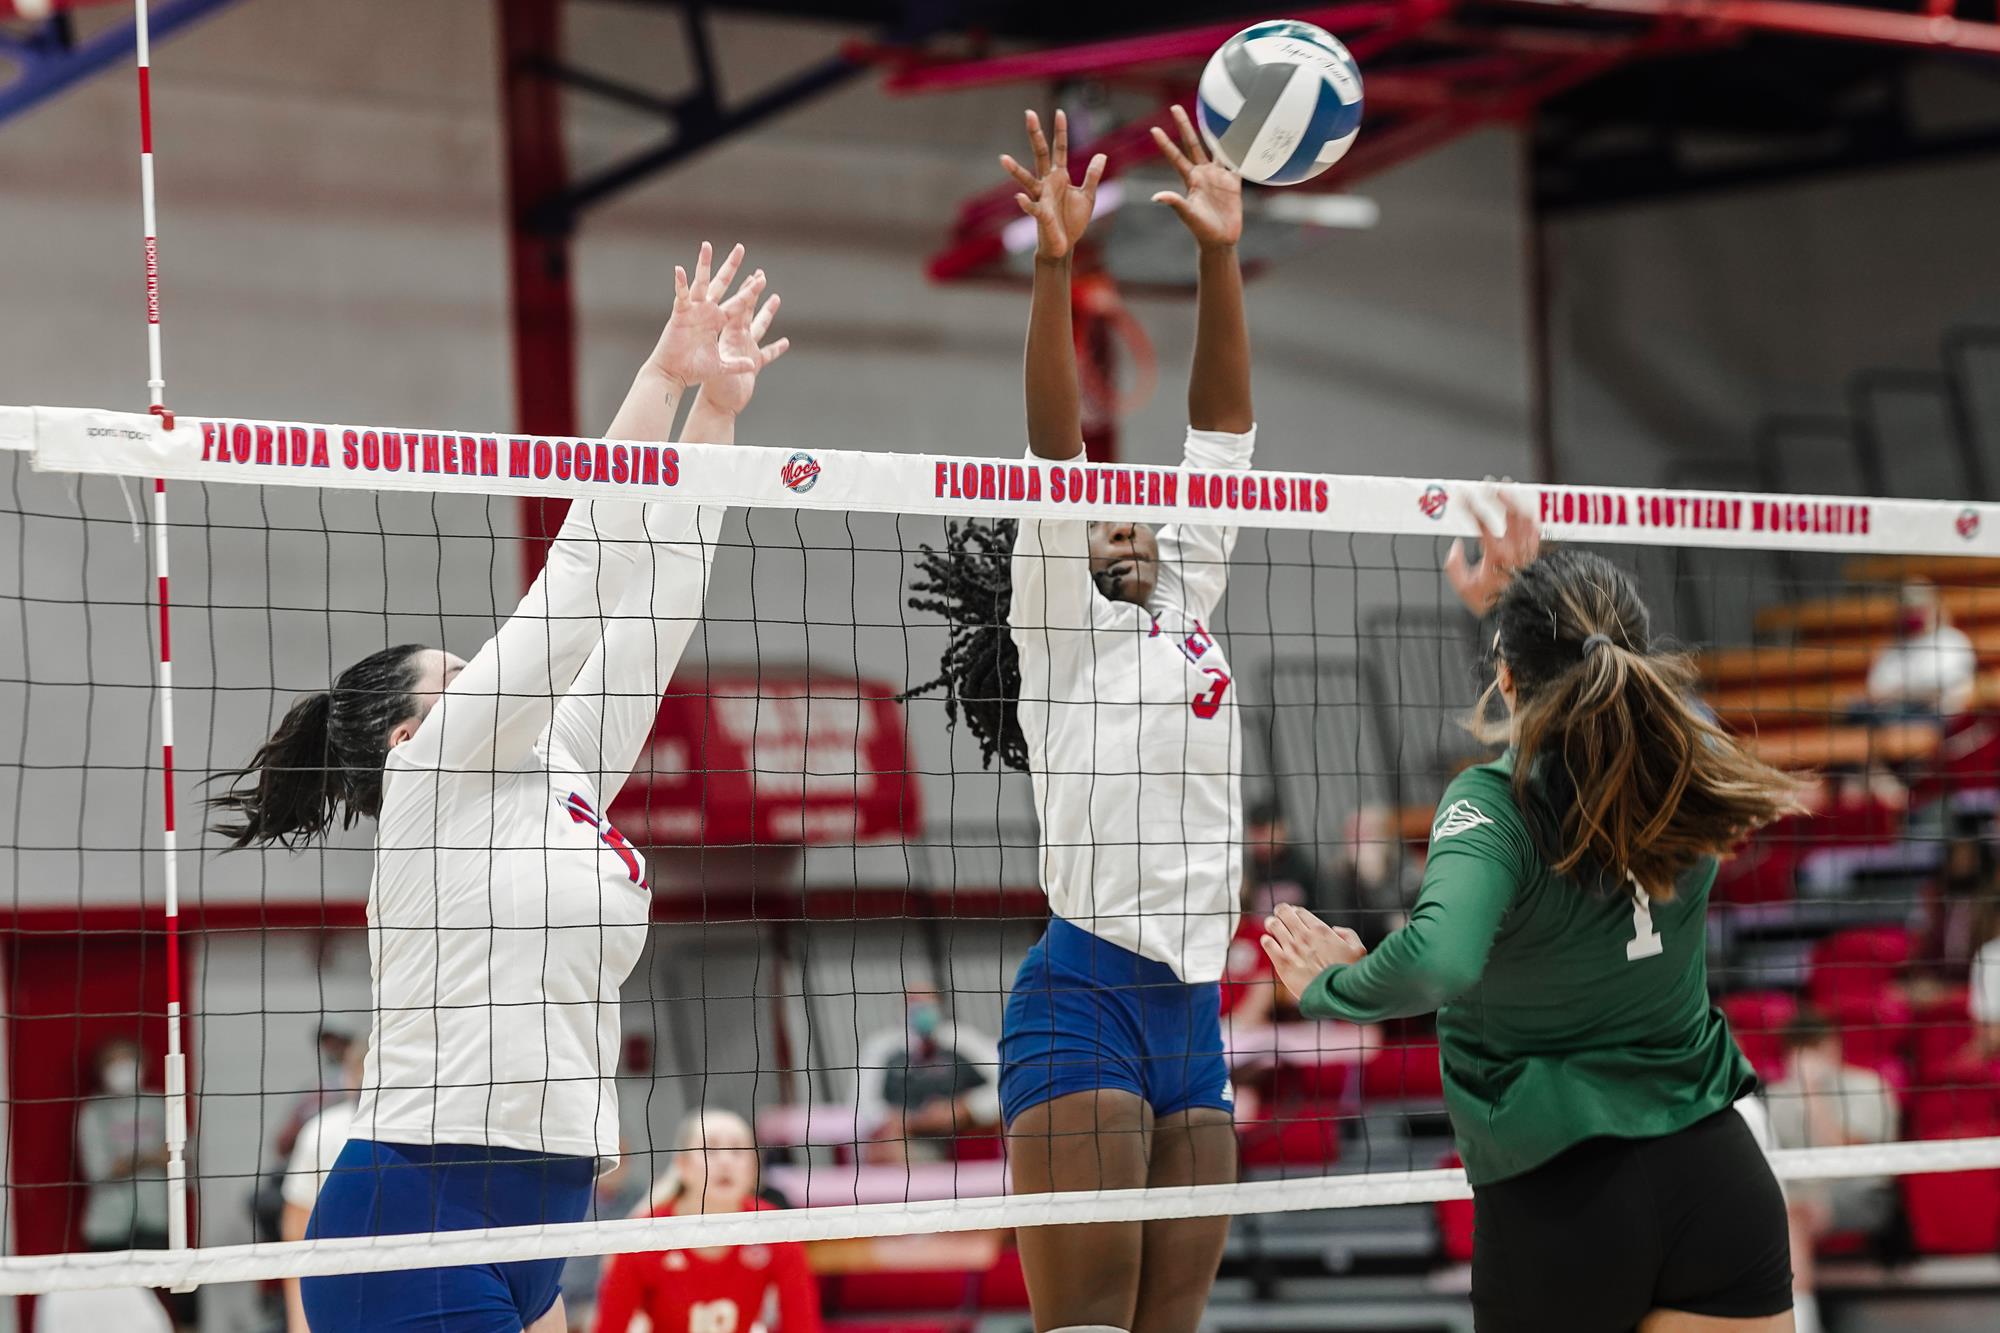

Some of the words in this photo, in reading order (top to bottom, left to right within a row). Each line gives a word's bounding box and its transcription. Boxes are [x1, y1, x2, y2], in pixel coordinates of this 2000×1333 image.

[200, 422, 330, 468] FLORIDA
[343, 429, 498, 477] SOUTHERN
[509, 439, 680, 487] MOCCASINS
[781, 459, 821, 486] Mocs
[935, 461, 1042, 501] FLORIDA
[1050, 466, 1178, 507] SOUTHERN
[1188, 473, 1329, 513] MOCCASINS
[1539, 491, 1628, 525] FLORIDA
[1626, 868, 1663, 961] 1
